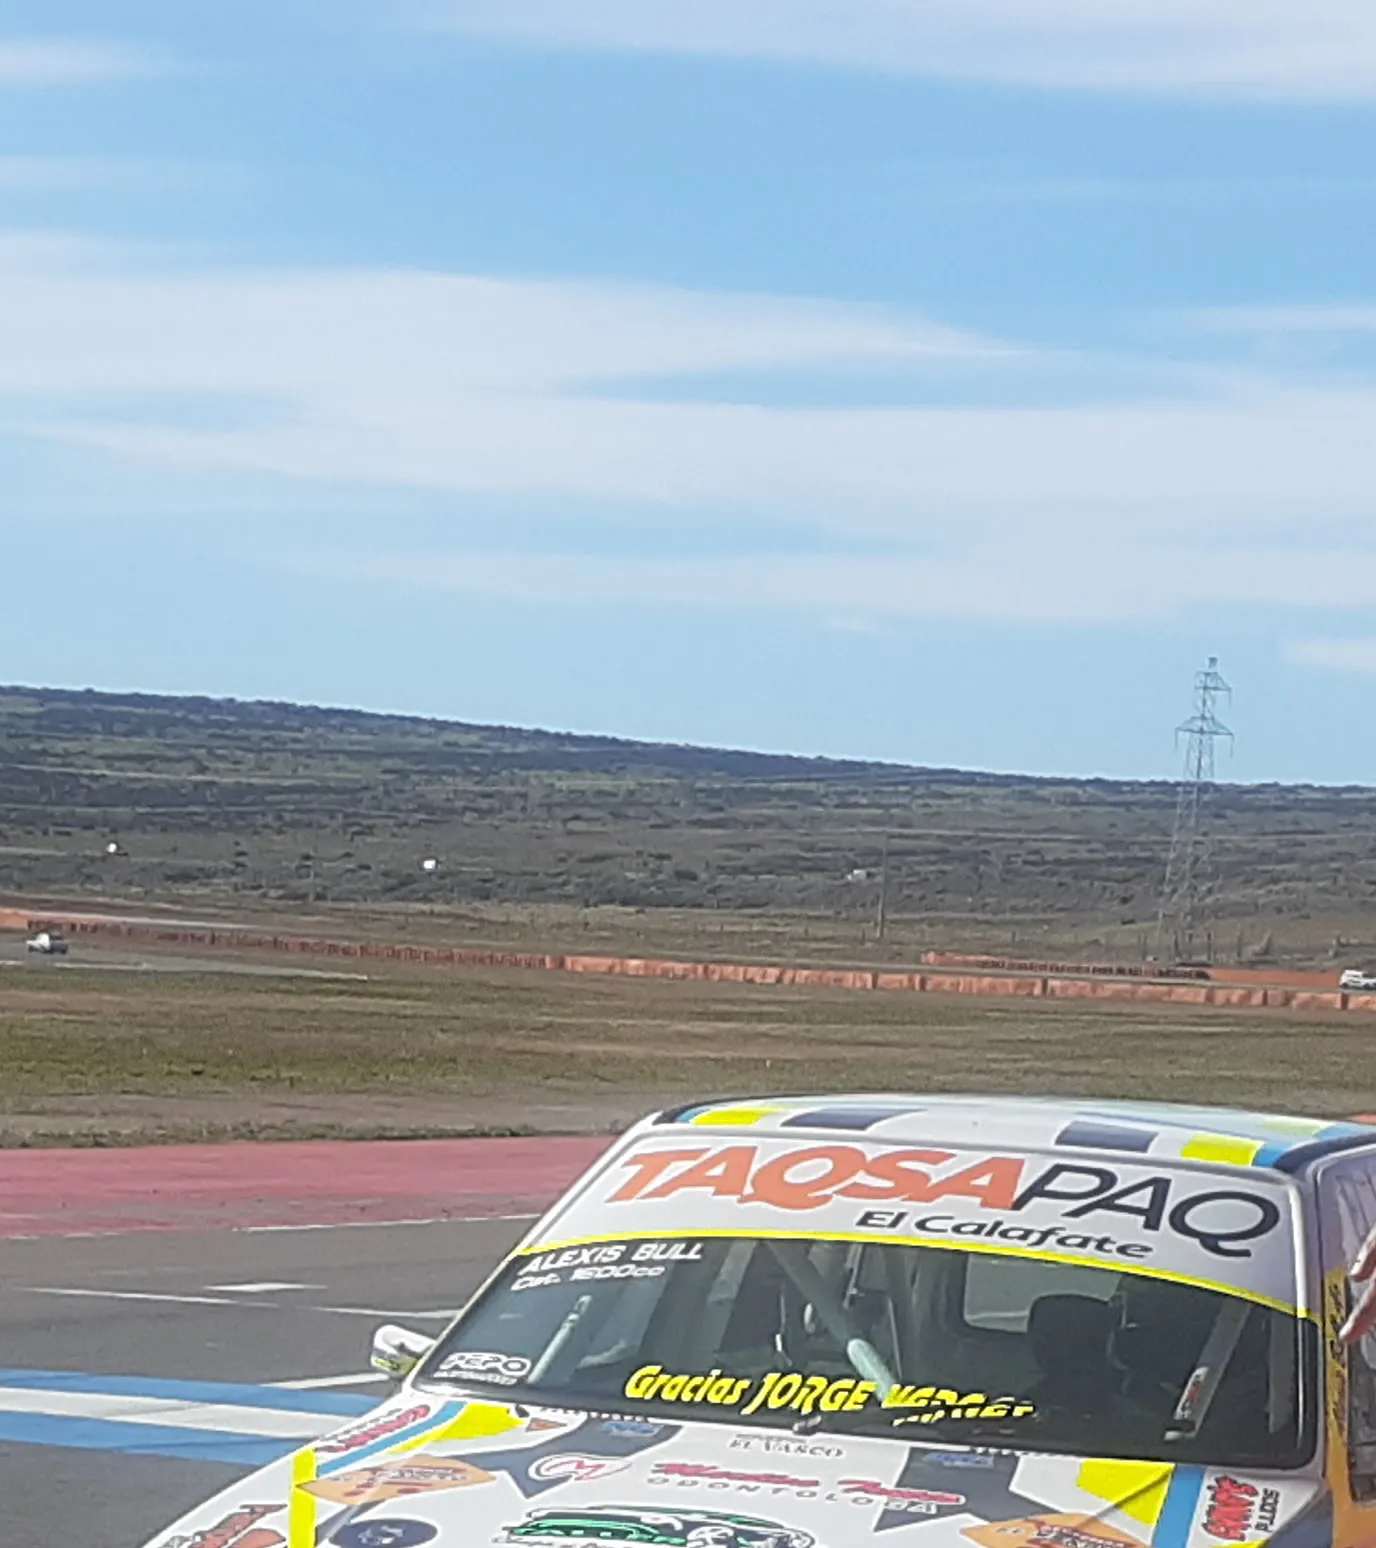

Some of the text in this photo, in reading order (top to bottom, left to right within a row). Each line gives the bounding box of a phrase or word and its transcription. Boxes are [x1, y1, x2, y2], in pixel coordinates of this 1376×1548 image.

[605, 1145, 1280, 1258] TAQSAPAQ
[518, 1243, 703, 1275] ALEXIS BULL
[856, 1210, 1154, 1259] El Calafate
[625, 1365, 752, 1404] Gracias
[741, 1373, 878, 1415] JORGE
